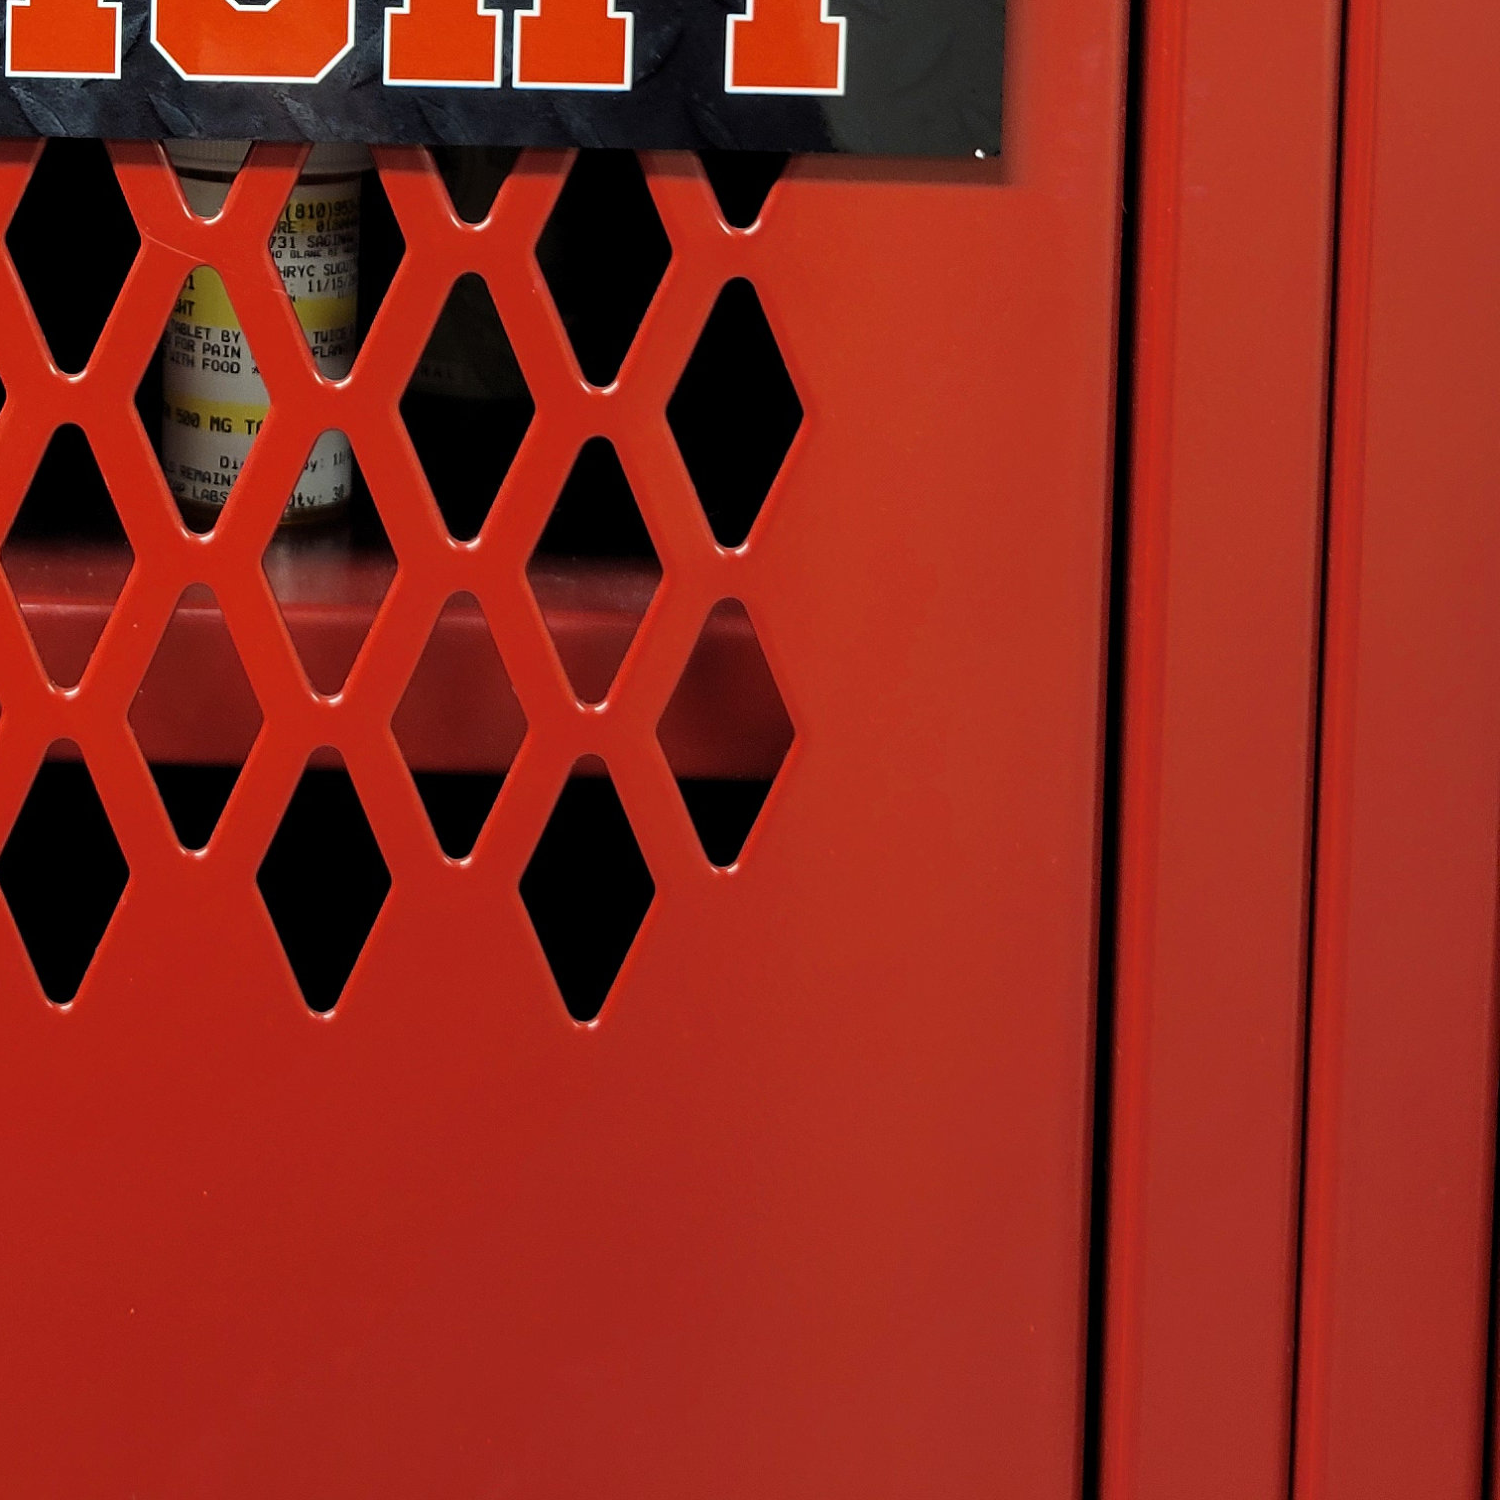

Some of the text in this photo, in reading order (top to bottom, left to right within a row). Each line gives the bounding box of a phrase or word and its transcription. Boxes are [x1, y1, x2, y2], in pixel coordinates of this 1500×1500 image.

[221, 330, 241, 344] BY
[202, 342, 241, 359] PAIN
[202, 358, 241, 375] FOOD
[209, 415, 233, 433] MG
